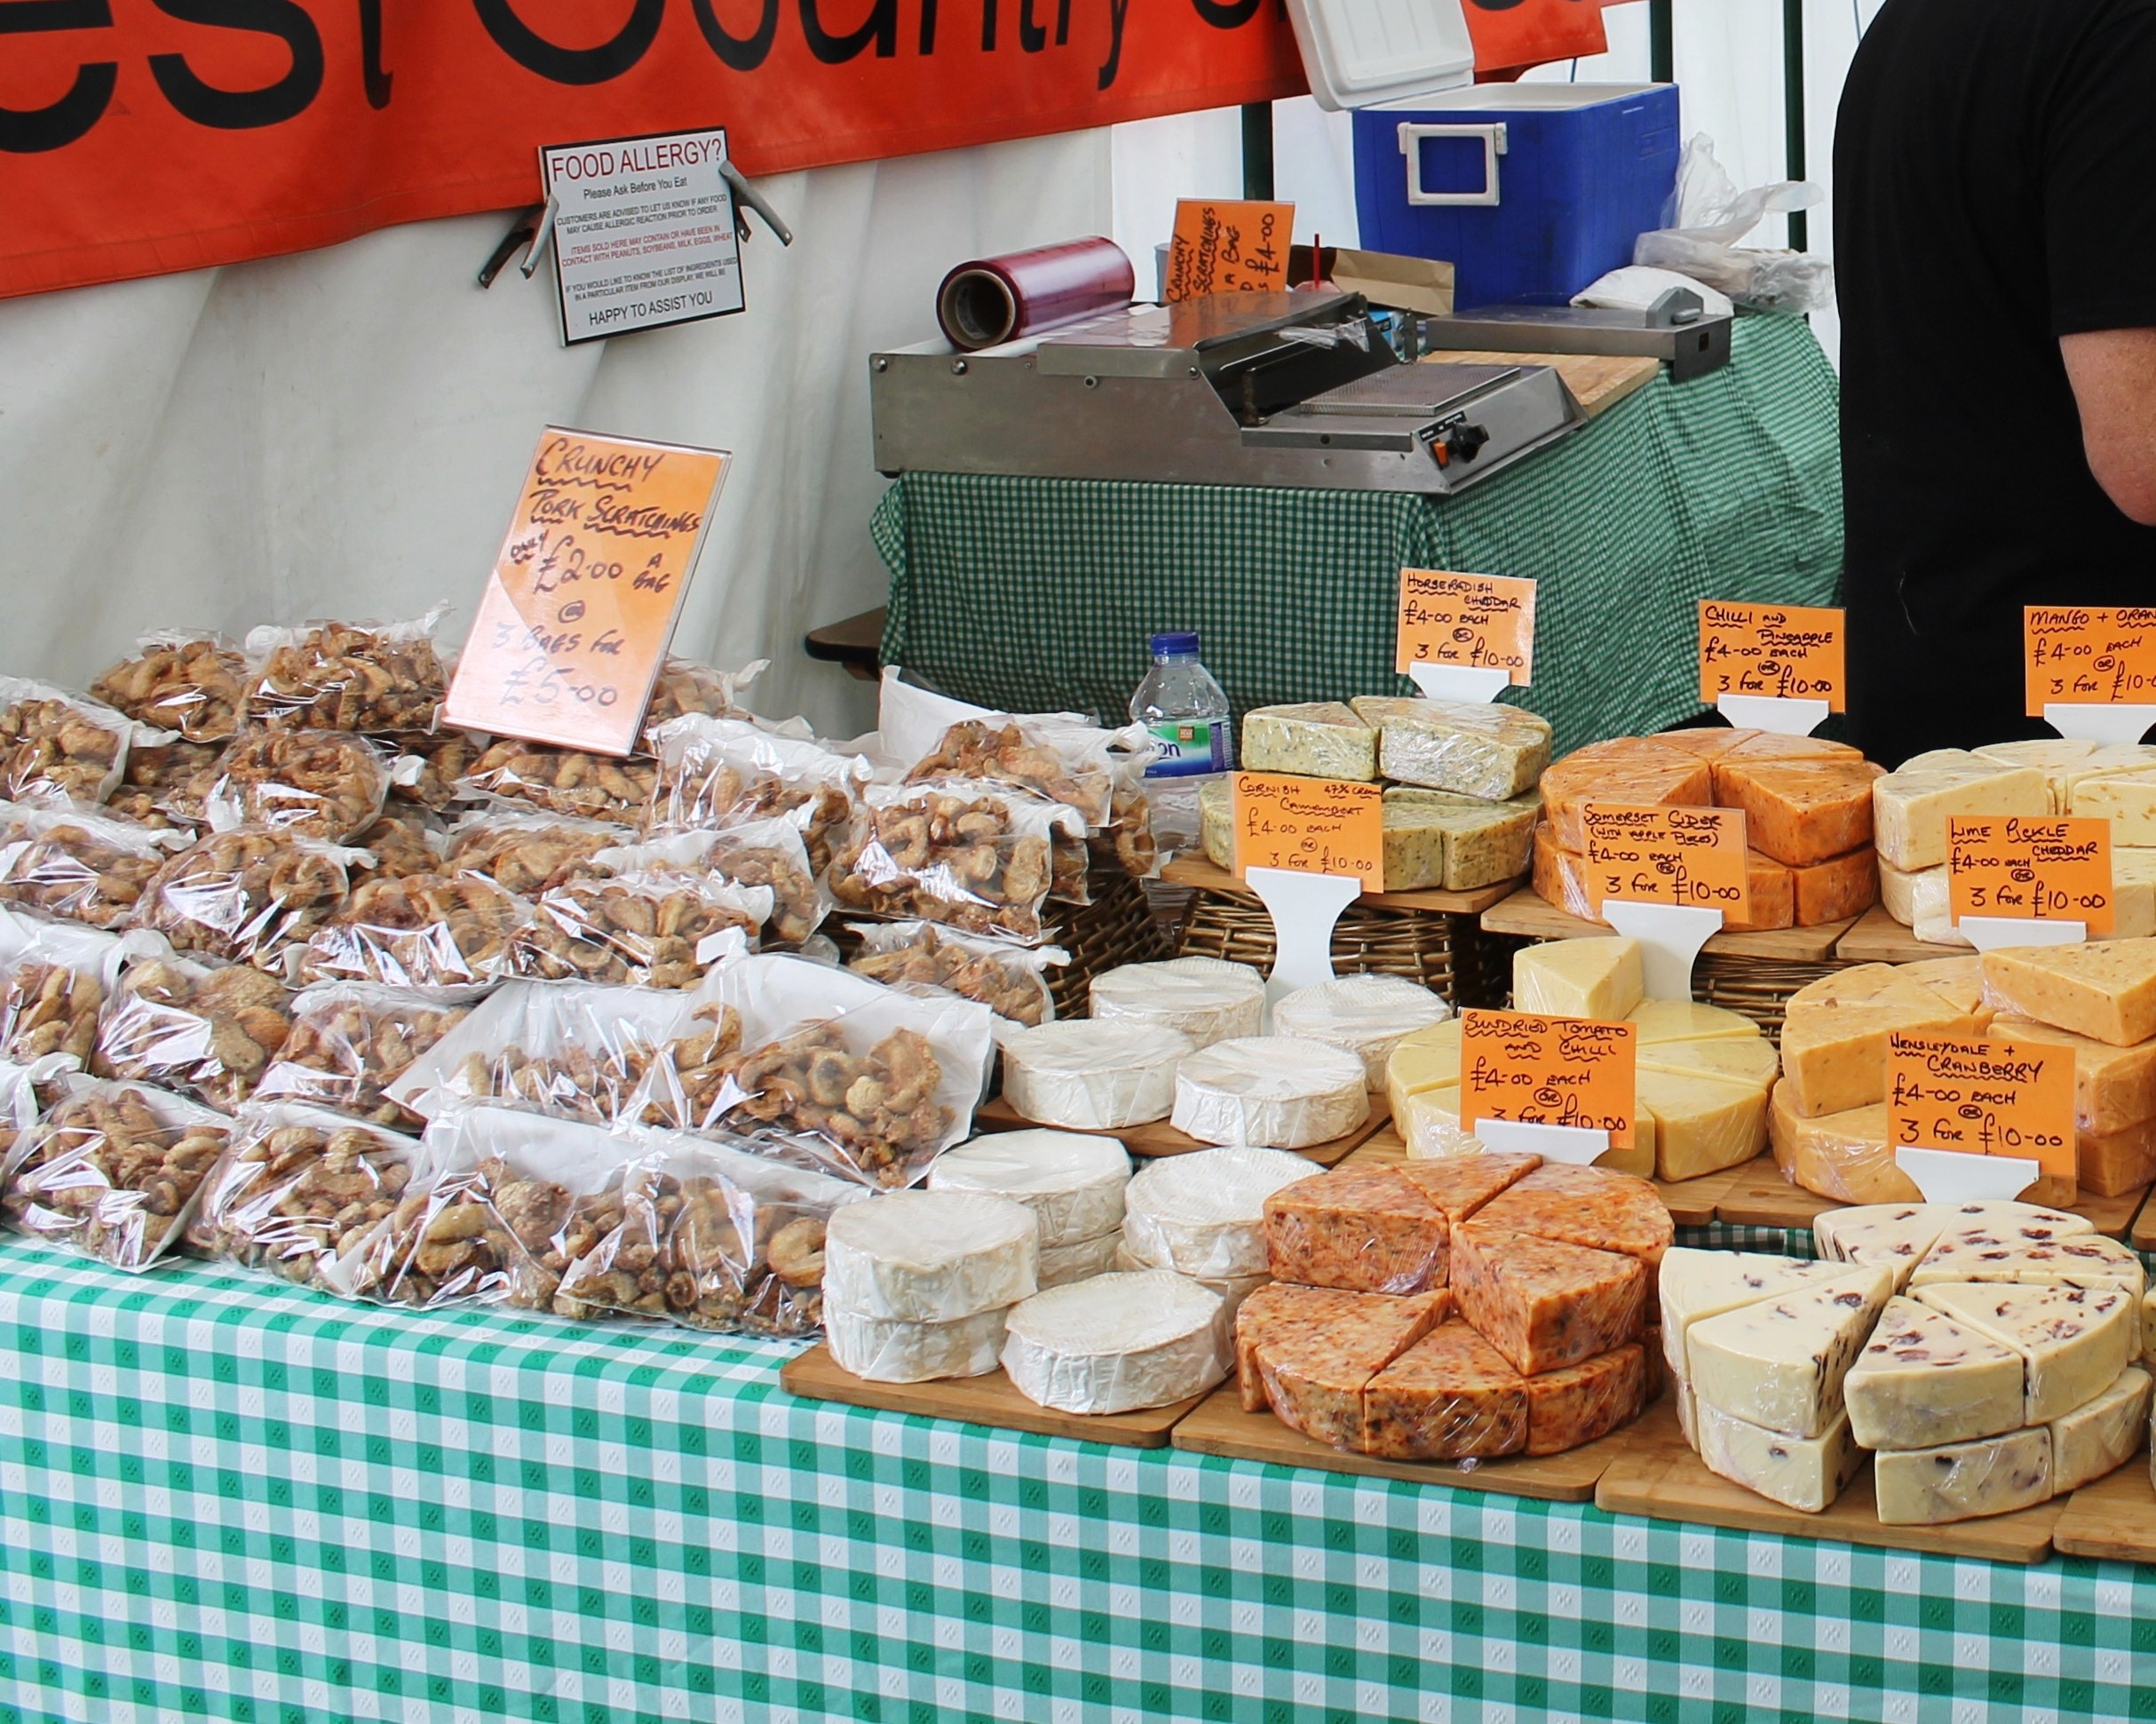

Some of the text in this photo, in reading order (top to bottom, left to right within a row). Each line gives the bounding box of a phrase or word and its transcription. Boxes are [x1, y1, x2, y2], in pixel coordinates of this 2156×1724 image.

[551, 138, 722, 181] FOOD ALLERGY?
[583, 177, 687, 200] Please Ask Before You Eat
[557, 212, 598, 226] CUSTOMERS
[613, 207, 639, 217] ADVISED
[650, 203, 661, 212] LET
[662, 202, 670, 211] US
[671, 199, 690, 208] KNOW
[710, 194, 727, 203] FOOD
[567, 226, 581, 234] MAY
[582, 223, 604, 232] CAUSE
[605, 218, 635, 228] ALLERGIC
[636, 213, 667, 224] REACTION
[668, 210, 686, 218] PRIOR
[697, 205, 717, 215] ORDER
[571, 244, 591, 255] ITEMS
[592, 242, 609, 251] SOLD
[611, 239, 627, 249] HERE
[643, 232, 670, 243] CONTAIN
[670, 230, 679, 239] OR
[680, 228, 696, 237] HAVE
[697, 226, 713, 234] BEEN
[562, 255, 591, 266] CONTACT
[593, 252, 610, 262] WITH
[587, 279, 608, 289] WOULD
[664, 267, 675, 276] LIST
[686, 259, 722, 272] INGREDIENTS
[587, 286, 623, 298] PARTICULAR
[639, 281, 656, 290] FROM
[589, 290, 712, 326] HAPPY TO ASSIST YOU
[535, 437, 665, 482] CRUNCHY
[529, 489, 703, 533] PORK SCRATCHINGS
[647, 552, 662, 568] A
[632, 570, 670, 593] BAG
[1407, 572, 1493, 593] HORSERADISH
[1705, 605, 1787, 624] CHILLI AND
[2030, 610, 2089, 625] MANGO
[2097, 613, 2109, 623] +
[493, 622, 512, 649] 3
[1415, 644, 1430, 658] 3
[1717, 675, 1731, 692] 3
[2050, 679, 2064, 695] 3
[1238, 775, 1300, 794] CORNISH
[1583, 803, 1722, 827] SOMERSET CIDER
[1951, 818, 2070, 839] LIME PICKLE
[1269, 851, 1280, 867] 3
[2032, 841, 2098, 856] CHEDDAR
[1605, 876, 1621, 893] 3
[1970, 887, 1986, 907] 3
[1465, 1012, 1628, 1037] SUNDRIED TOMATO
[1504, 1040, 1616, 1055] AND CHILLI
[1890, 1032, 2015, 1056] WENSLEYDALE +
[1546, 1069, 1590, 1085] EACH
[1927, 1054, 2044, 1083] CRANBERRY
[1900, 1118, 1919, 1143] 3
